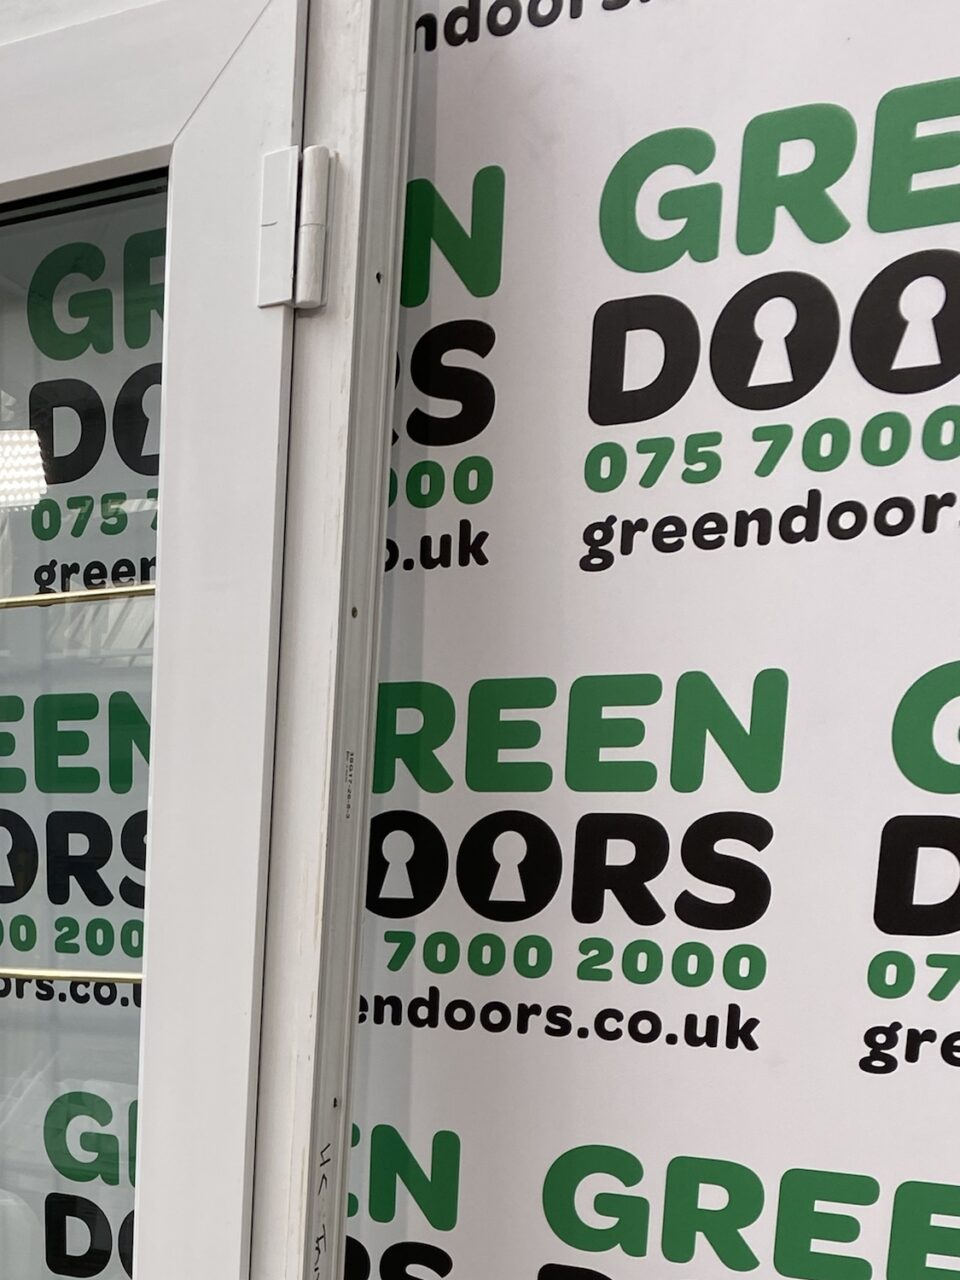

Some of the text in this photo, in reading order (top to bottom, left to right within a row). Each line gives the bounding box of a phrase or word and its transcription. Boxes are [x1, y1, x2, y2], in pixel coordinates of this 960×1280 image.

[588, 250, 960, 426] DOO
[584, 406, 960, 493] 075 7000
[371, 669, 788, 795] REEN
[384, 930, 766, 990] 7000 2000
